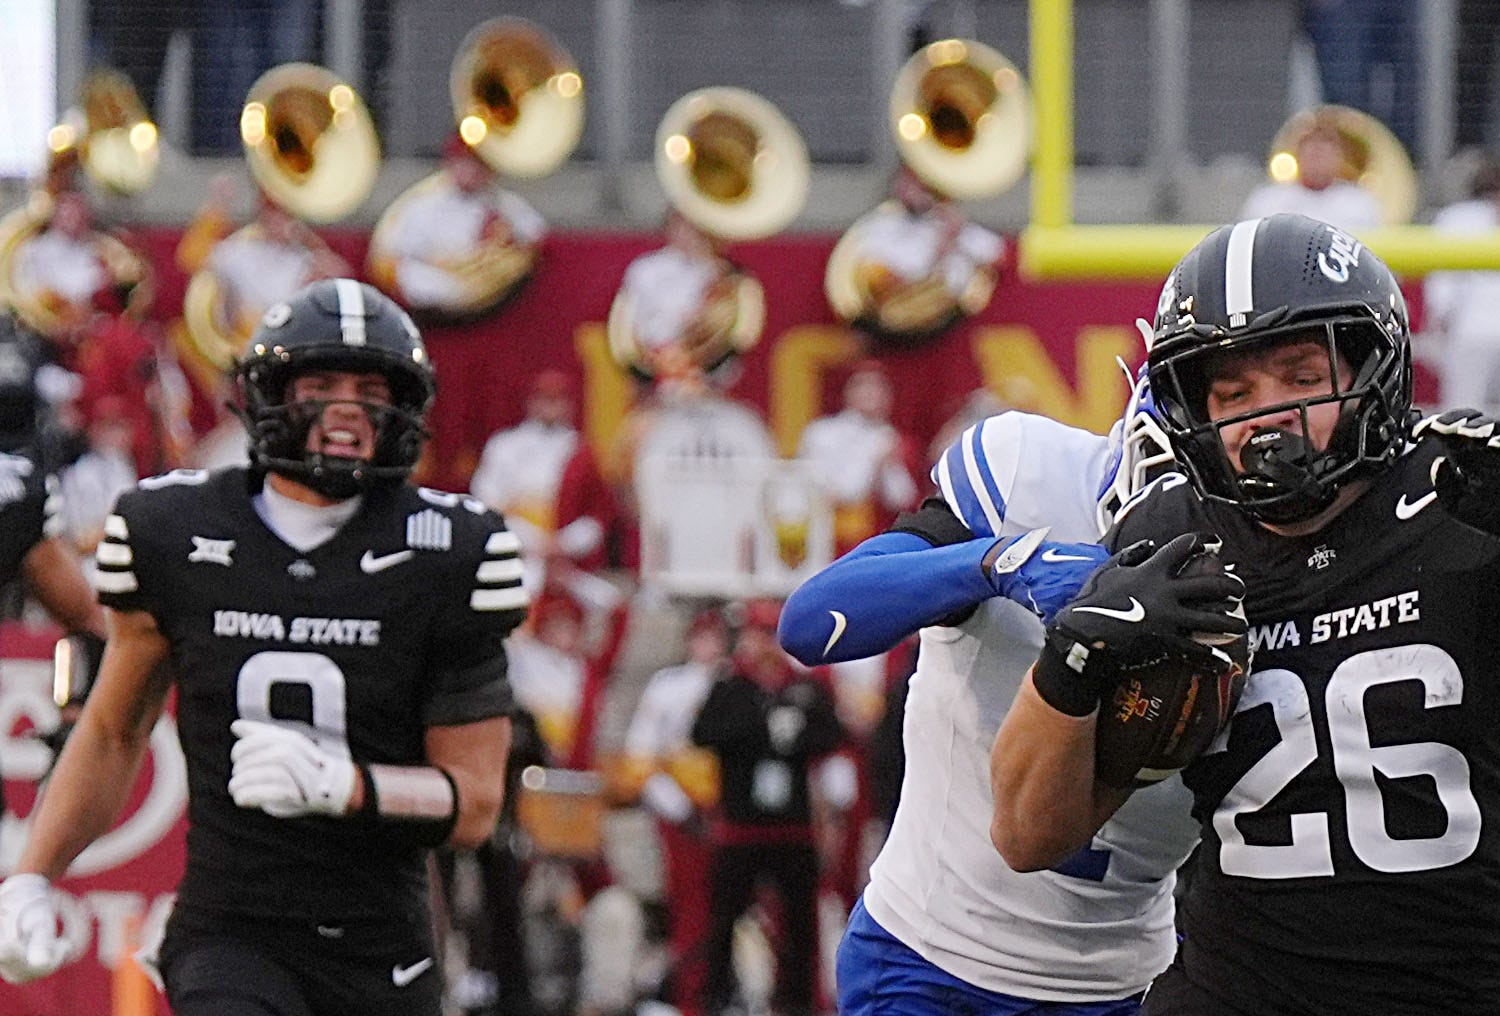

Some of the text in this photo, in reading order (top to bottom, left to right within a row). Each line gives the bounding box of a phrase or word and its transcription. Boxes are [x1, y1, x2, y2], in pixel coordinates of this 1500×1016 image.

[213, 610, 381, 646] IOWA STATE
[1249, 590, 1421, 652] WA STATE
[1212, 643, 1482, 880] 26
